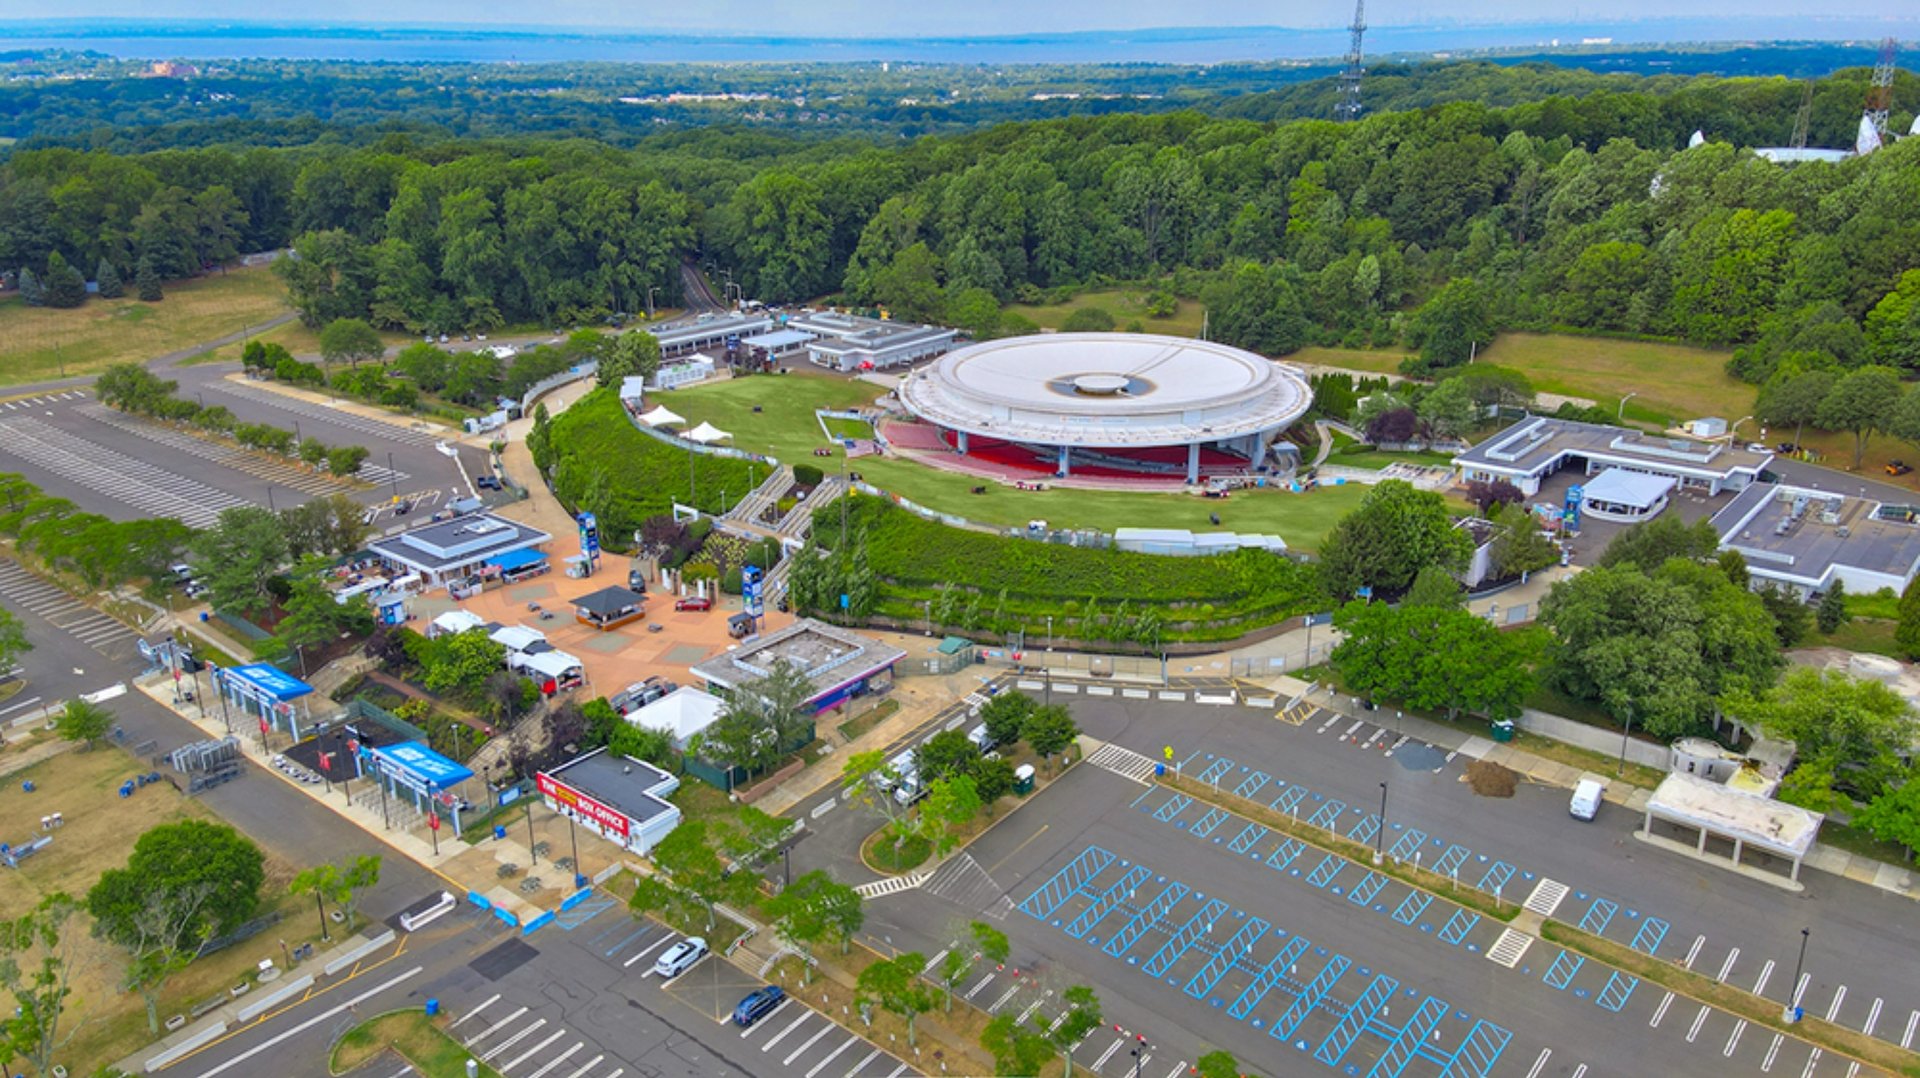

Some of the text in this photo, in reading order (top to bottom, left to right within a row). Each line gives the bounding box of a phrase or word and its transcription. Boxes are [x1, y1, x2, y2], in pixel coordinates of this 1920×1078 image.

[541, 778, 624, 829] THE BOX OFFICE
